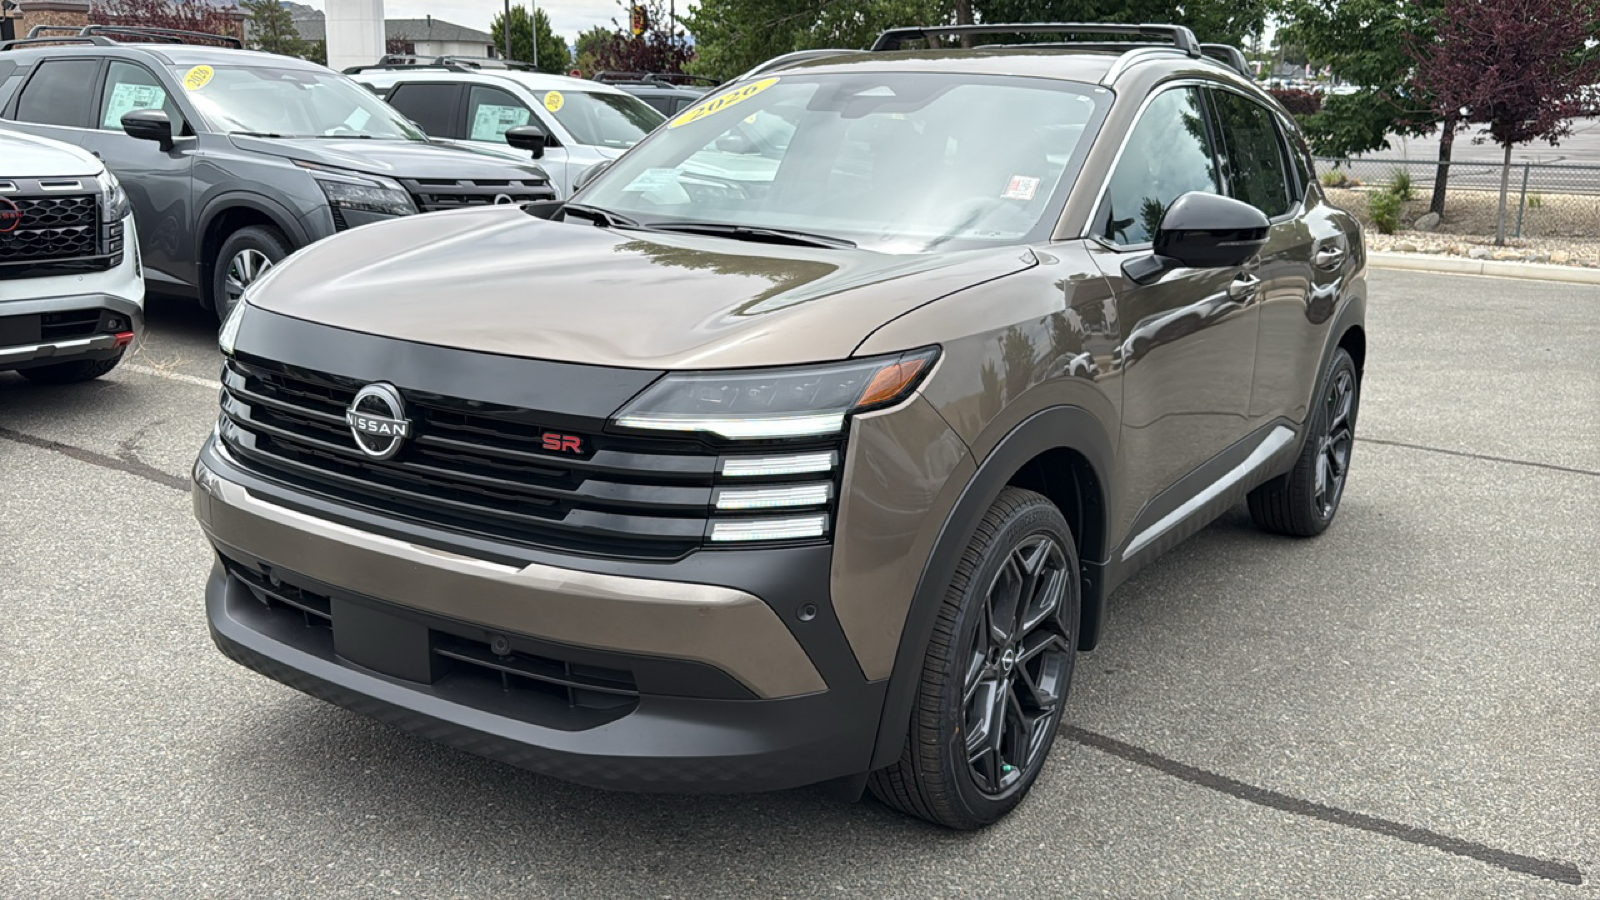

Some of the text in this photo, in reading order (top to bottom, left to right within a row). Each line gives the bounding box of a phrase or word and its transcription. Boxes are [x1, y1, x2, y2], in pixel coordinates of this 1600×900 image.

[690, 86, 758, 121] 2026
[346, 413, 406, 436] NISSAN
[541, 433, 581, 454] SR
